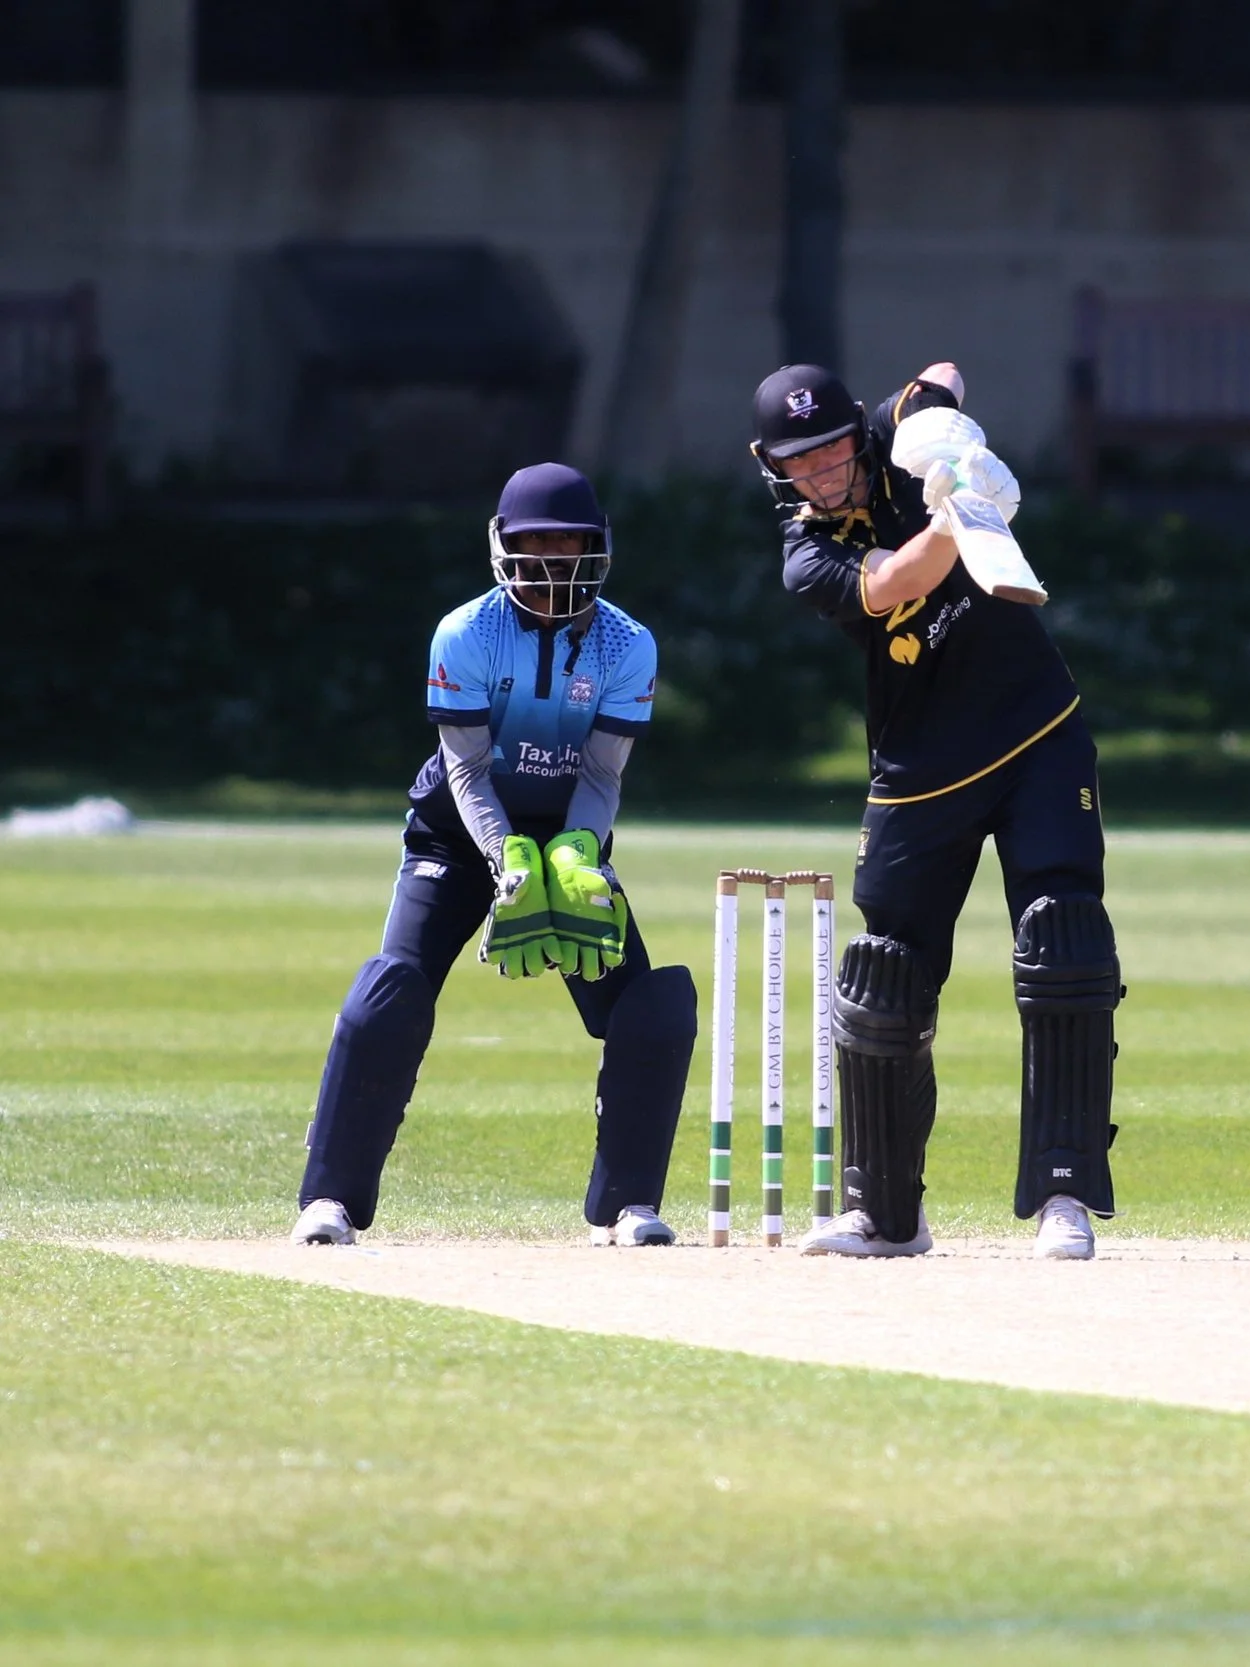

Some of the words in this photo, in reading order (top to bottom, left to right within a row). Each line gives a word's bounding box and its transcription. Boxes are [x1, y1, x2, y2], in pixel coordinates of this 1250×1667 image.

[927, 602, 952, 639] Jones
[929, 596, 971, 649] Enginering
[518, 742, 553, 764] Tax
[769, 927, 781, 1014] CHOICE
[817, 928, 829, 1016] CHOICE
[768, 1022, 781, 1045] BY
[816, 1025, 829, 1046] BY
[768, 1055, 781, 1089] GM
[817, 1056, 830, 1090] GM
[1052, 1168, 1072, 1177] BTC
[847, 1185, 862, 1199] BTC
